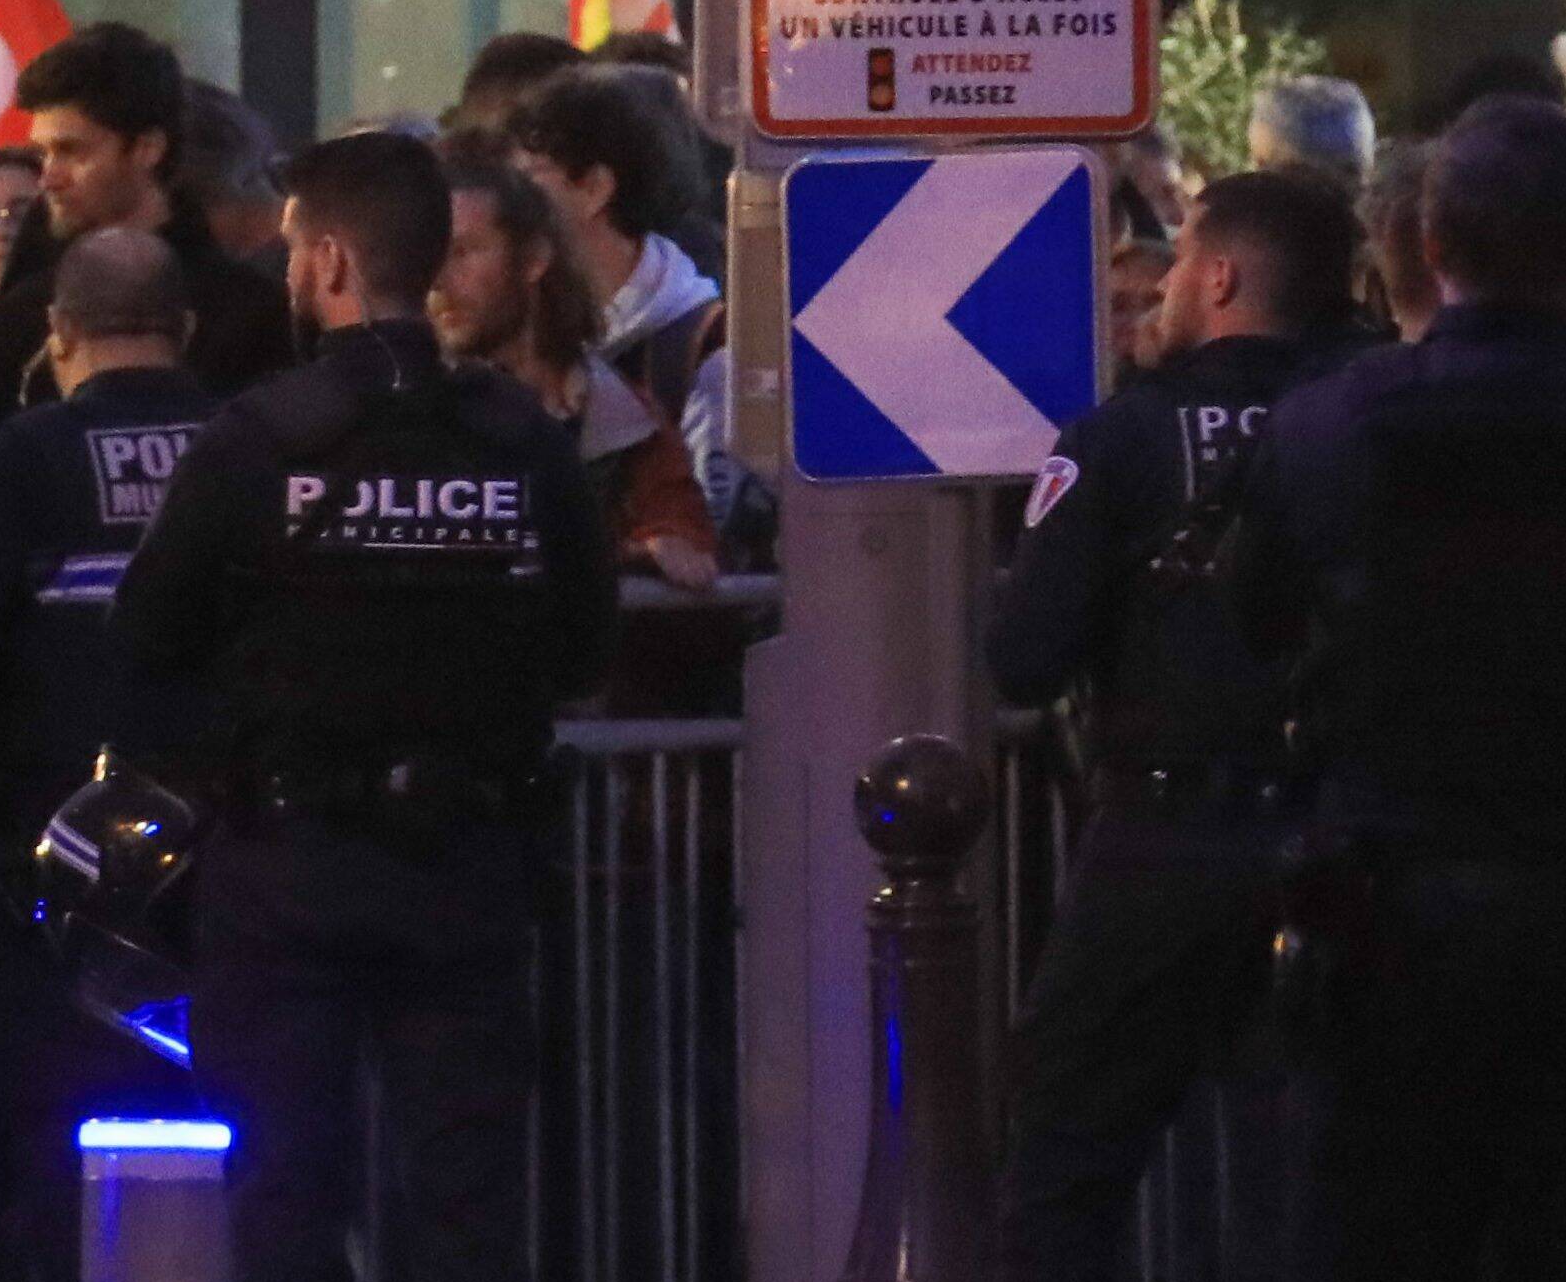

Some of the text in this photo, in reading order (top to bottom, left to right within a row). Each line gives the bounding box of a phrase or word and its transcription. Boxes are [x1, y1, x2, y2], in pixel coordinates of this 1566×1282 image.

[780, 10, 1117, 39] UN VÉHICULE À LA FOIS
[911, 53, 1033, 74] ATTENDEZ
[929, 85, 1017, 105] PASSEZ
